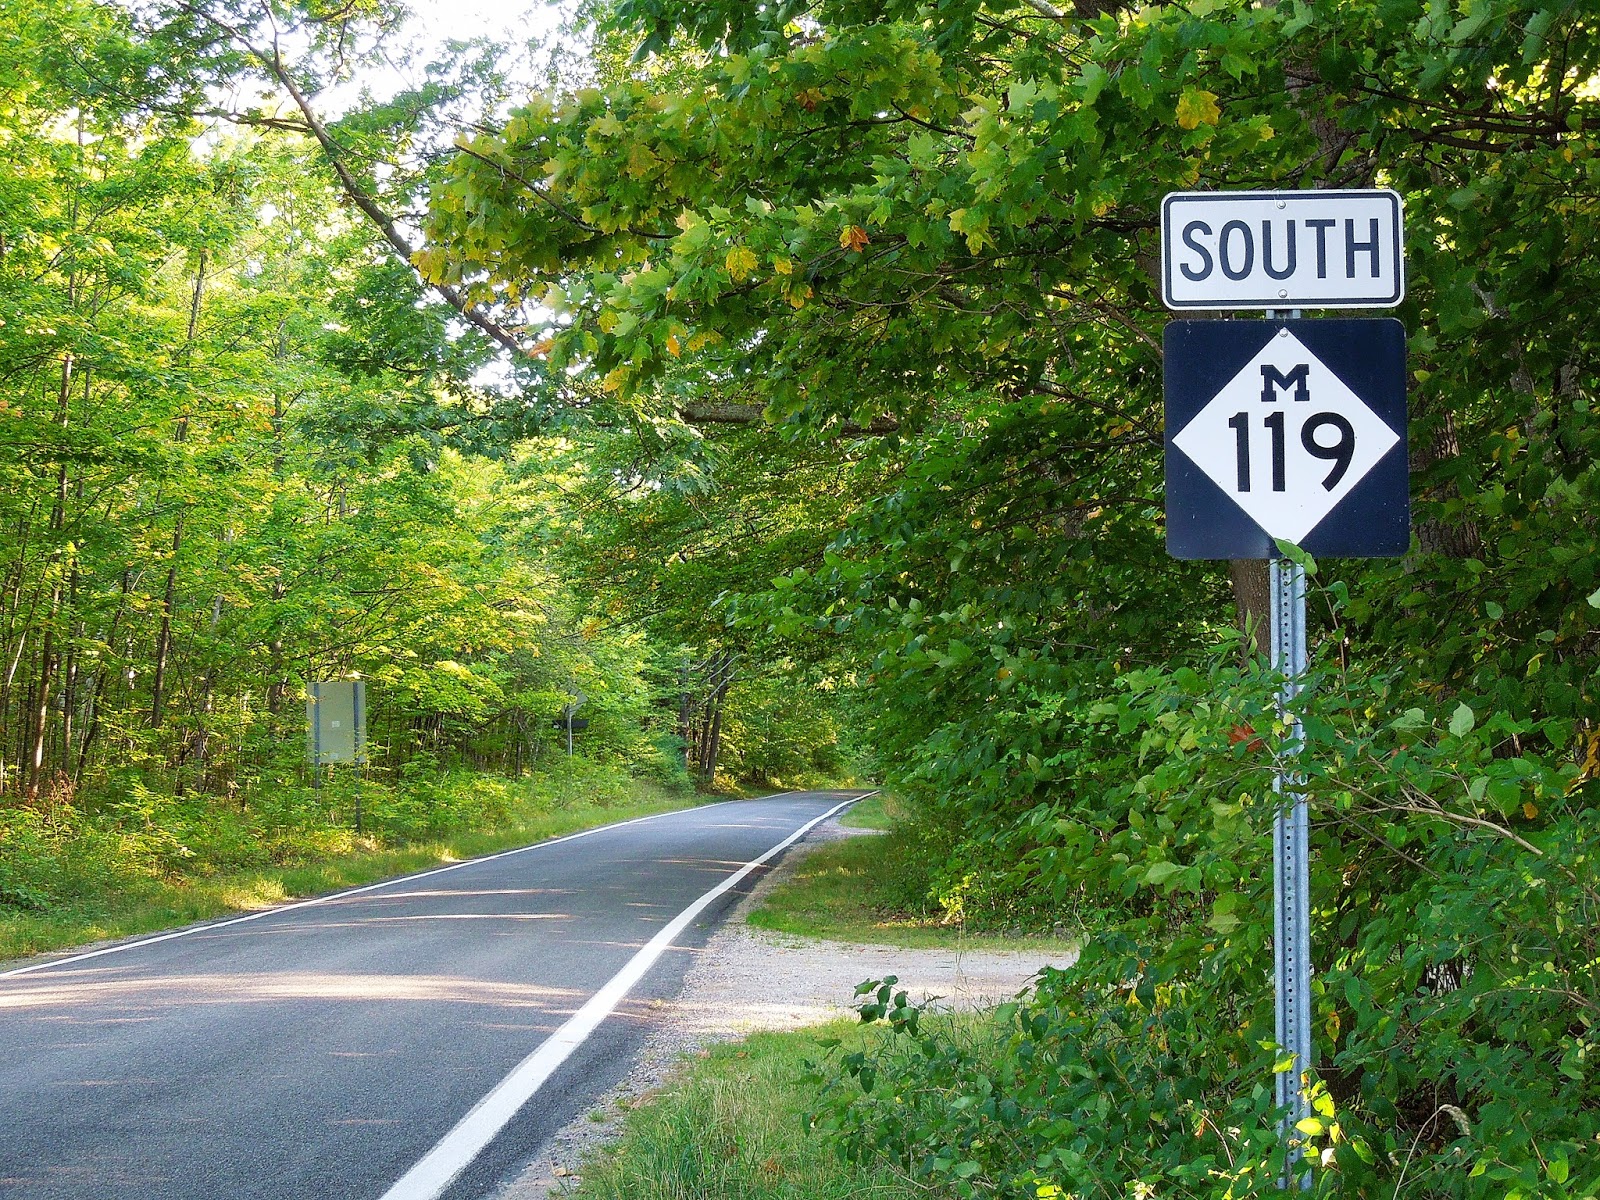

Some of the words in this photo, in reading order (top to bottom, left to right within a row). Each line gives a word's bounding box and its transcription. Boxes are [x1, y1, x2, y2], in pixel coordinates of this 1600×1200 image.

[1179, 218, 1380, 282] SOUTH
[1260, 363, 1310, 402] M
[1228, 411, 1355, 493] 119
